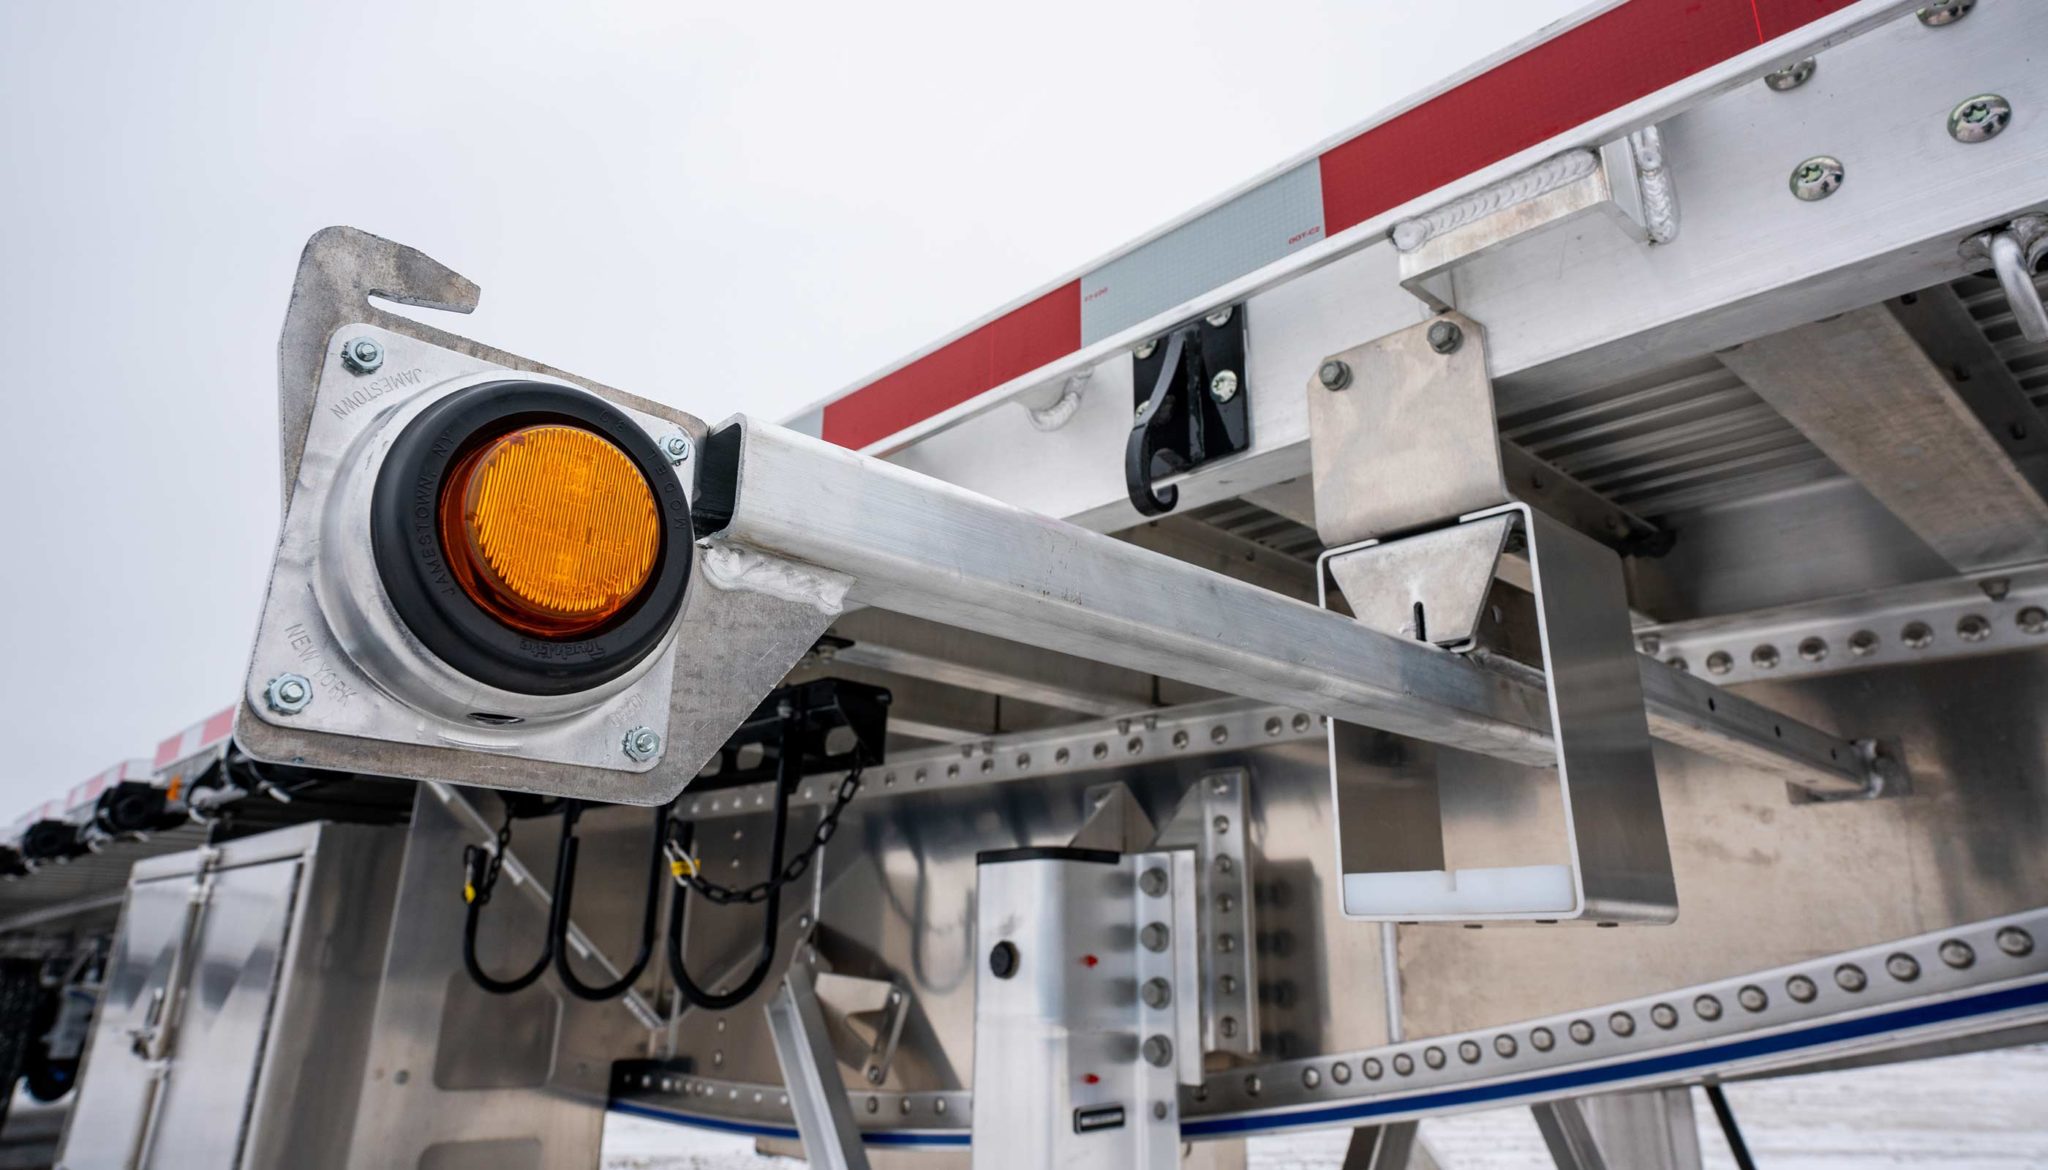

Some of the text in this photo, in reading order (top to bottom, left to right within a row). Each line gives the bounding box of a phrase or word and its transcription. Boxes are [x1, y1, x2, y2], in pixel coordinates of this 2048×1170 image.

[329, 367, 422, 420] JAMESTOWN
[647, 448, 688, 530] MODEL
[284, 622, 359, 708] NEW YORK
